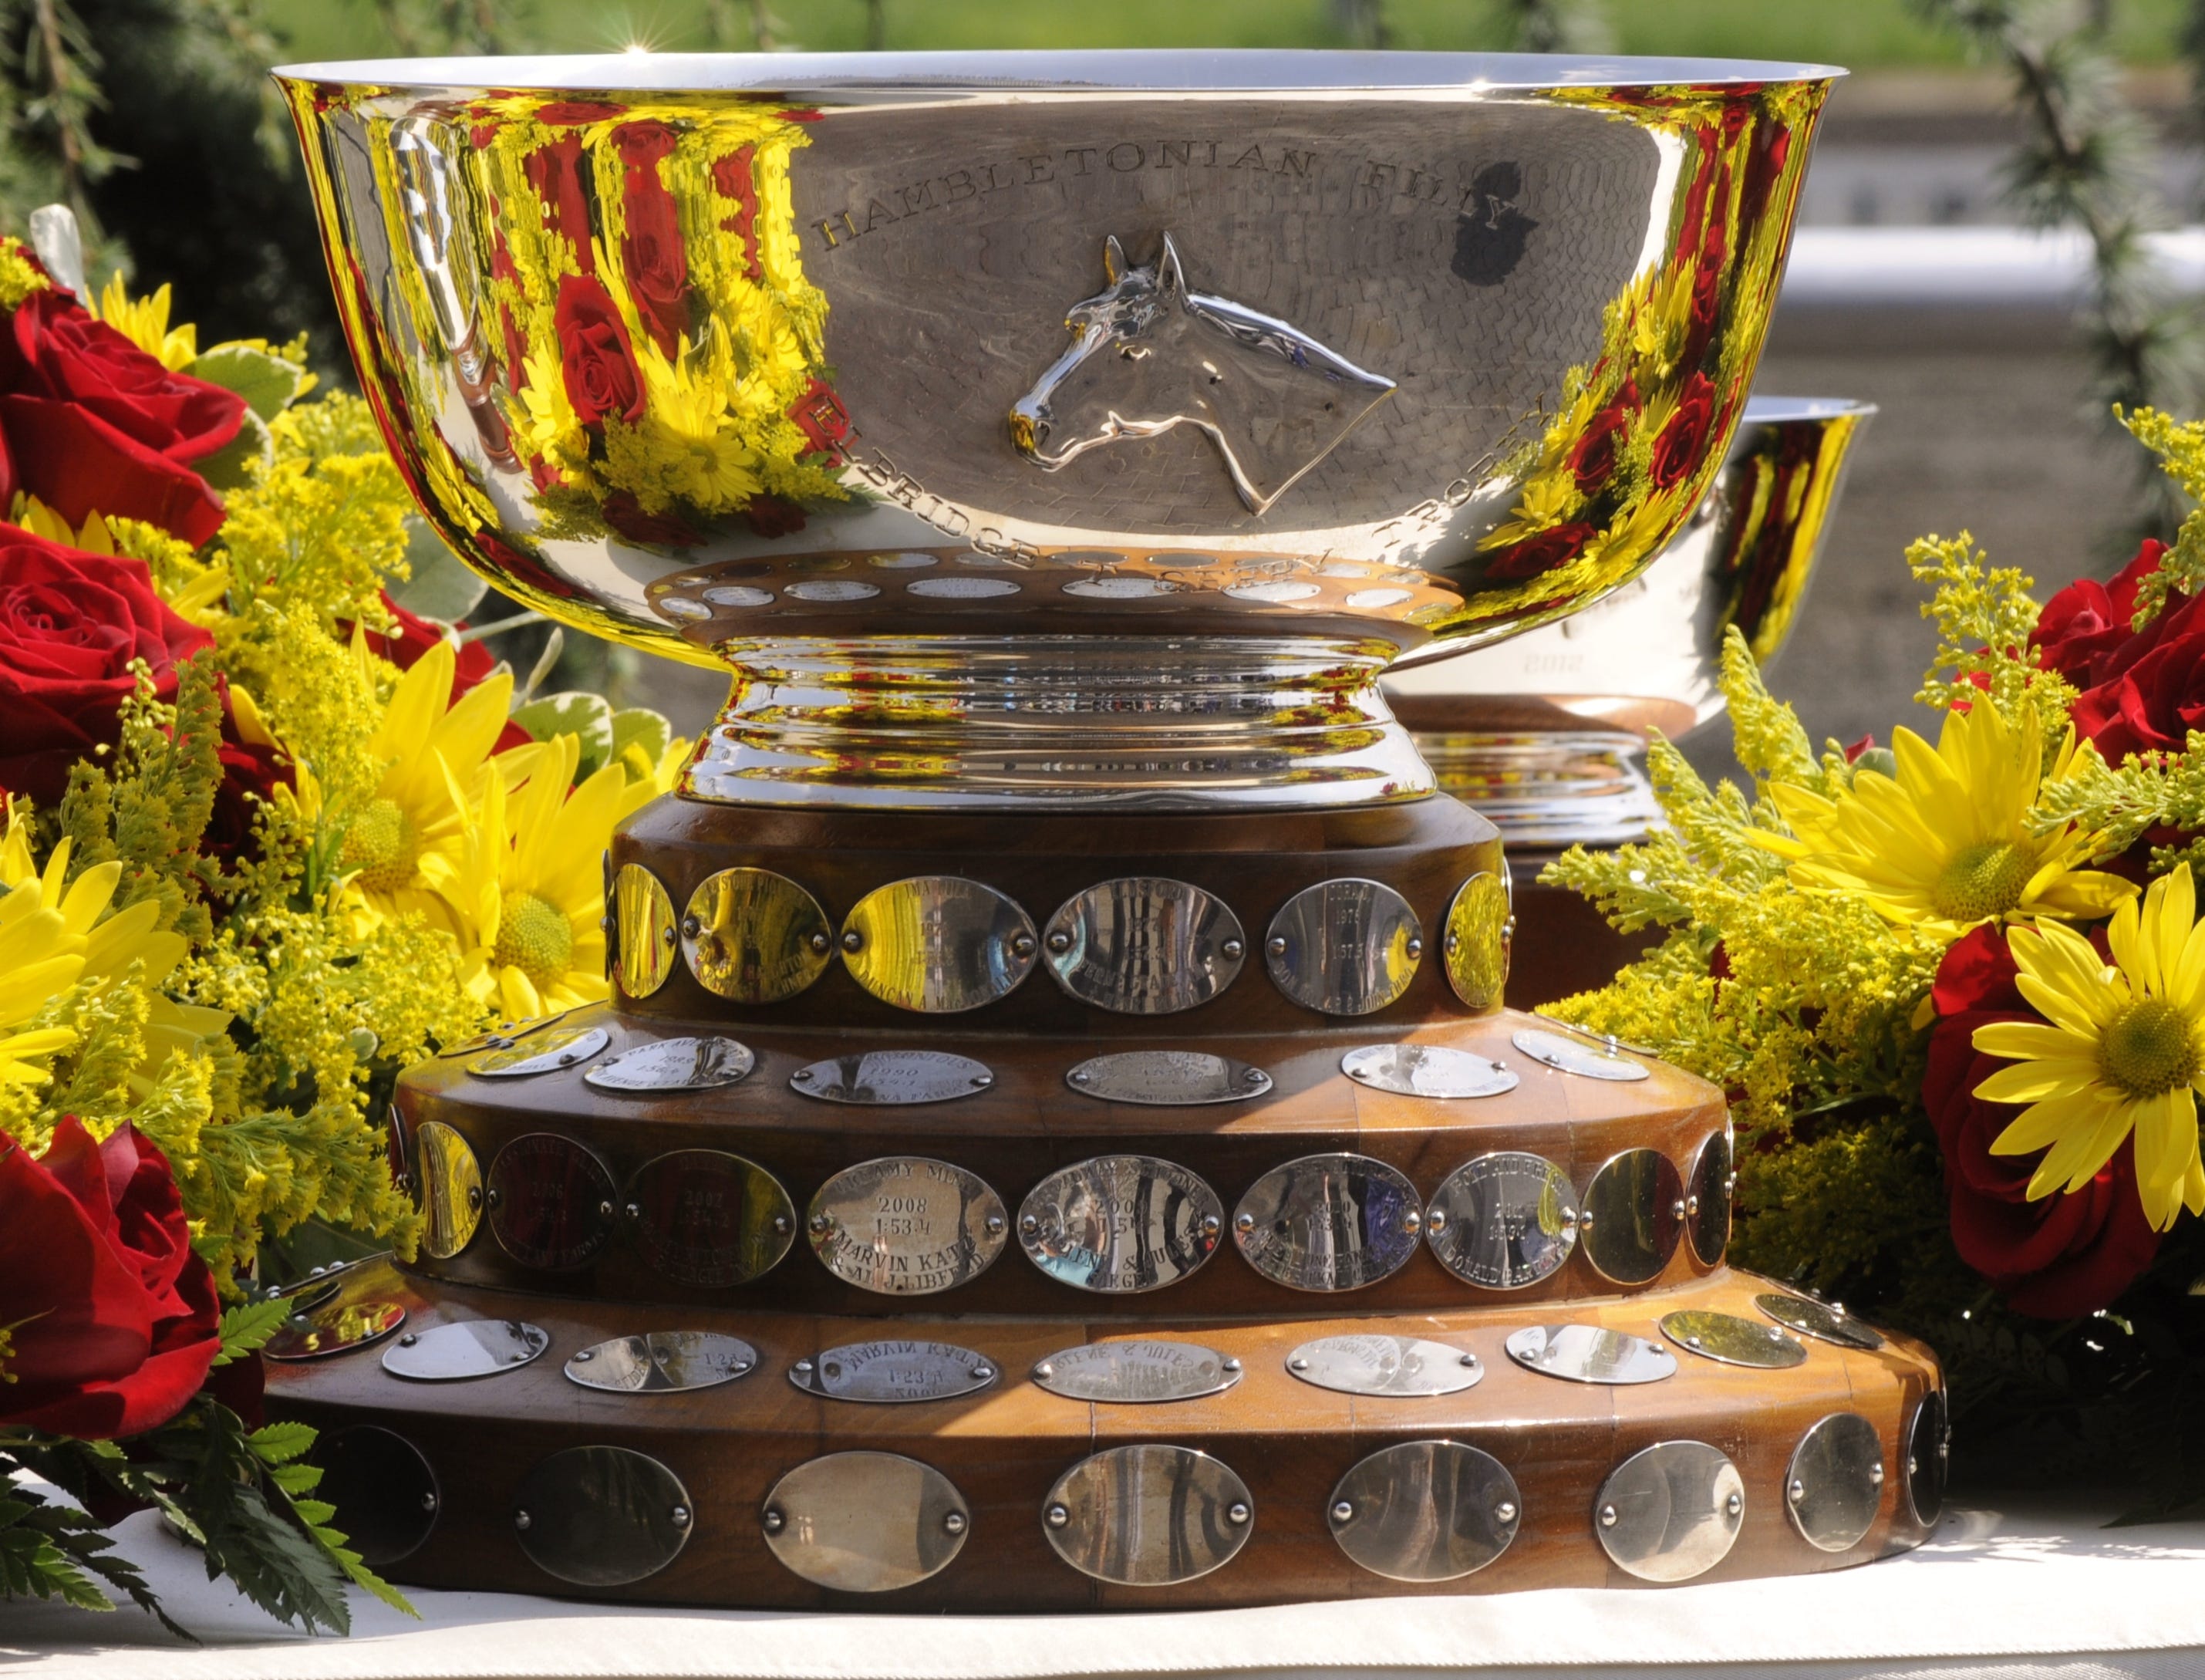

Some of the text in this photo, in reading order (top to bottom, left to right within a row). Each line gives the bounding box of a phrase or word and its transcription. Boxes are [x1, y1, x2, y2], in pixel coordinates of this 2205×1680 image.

[811, 139, 1316, 251] HAMBLETONIAN
[878, 1196, 928, 1213] 2008
[834, 1230, 909, 1272] MARVIN
